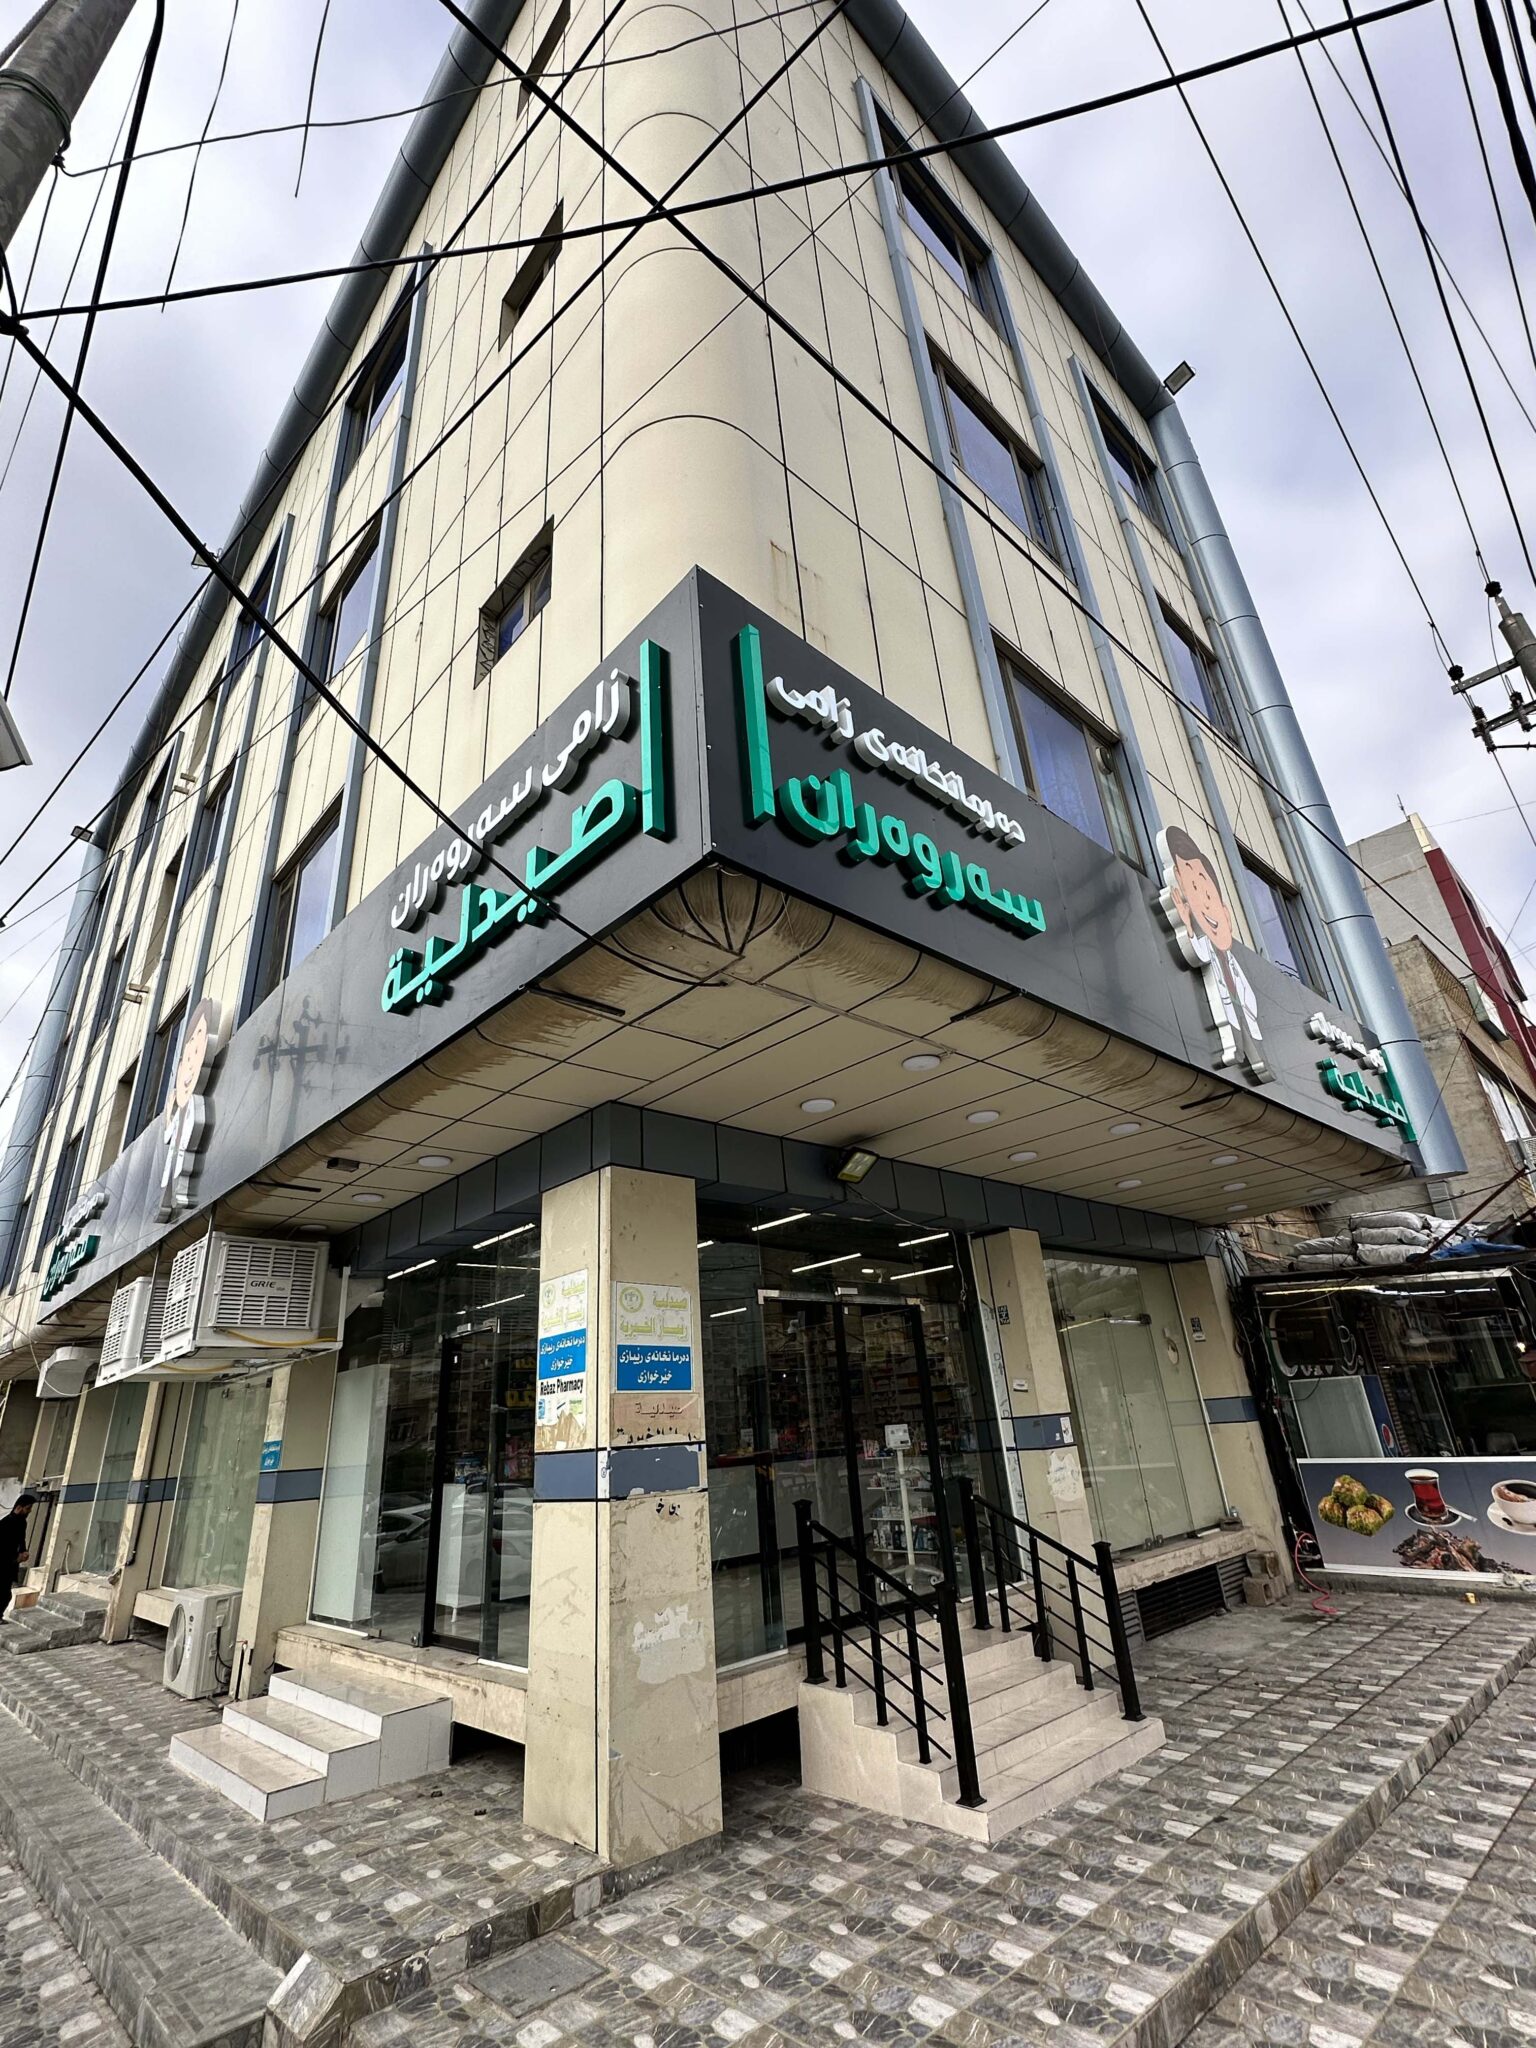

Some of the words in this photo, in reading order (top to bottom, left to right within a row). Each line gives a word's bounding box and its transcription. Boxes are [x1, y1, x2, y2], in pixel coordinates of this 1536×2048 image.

[381, 778, 637, 1014] صيدلية
[540, 1381, 556, 1396] Rebaz
[556, 1378, 584, 1394] Pharmacy
